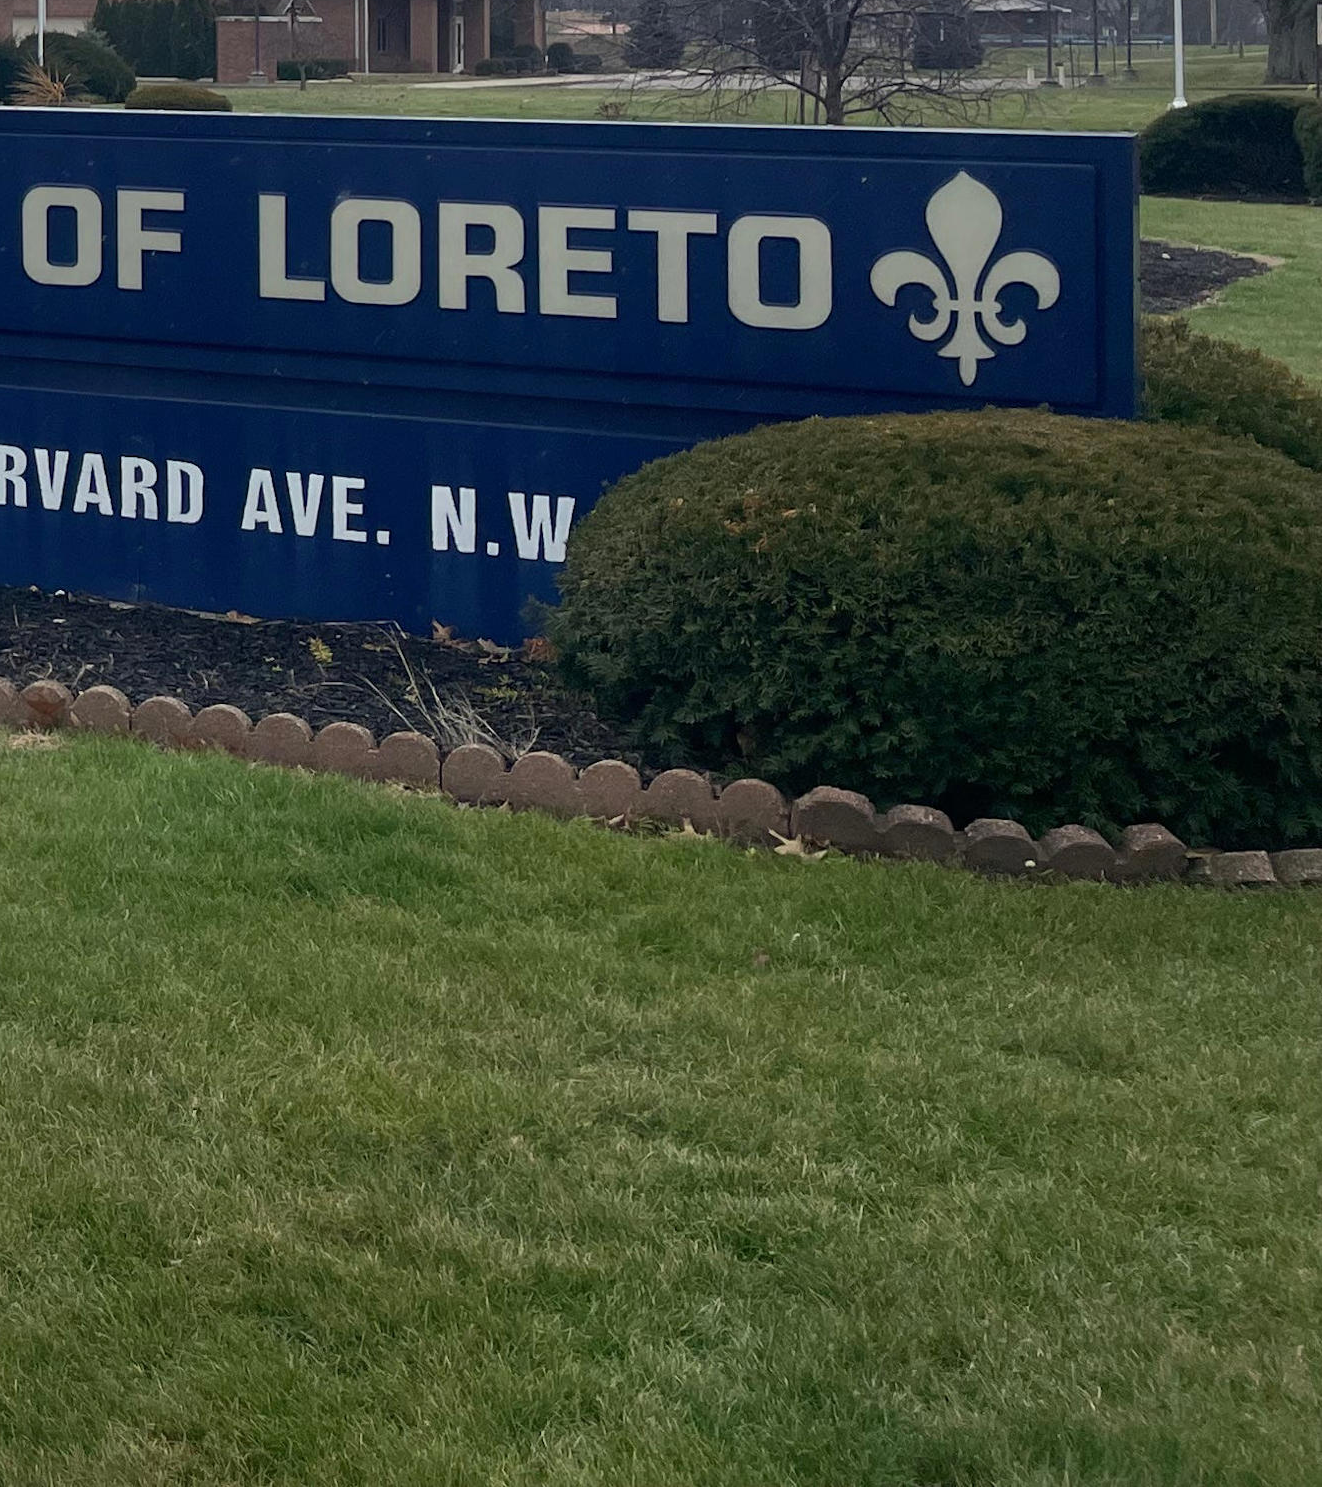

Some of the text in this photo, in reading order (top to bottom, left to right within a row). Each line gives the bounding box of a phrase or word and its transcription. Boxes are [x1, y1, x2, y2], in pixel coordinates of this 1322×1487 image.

[21, 185, 185, 291] OF
[258, 193, 833, 331] LORETO
[240, 467, 391, 546] AVE.
